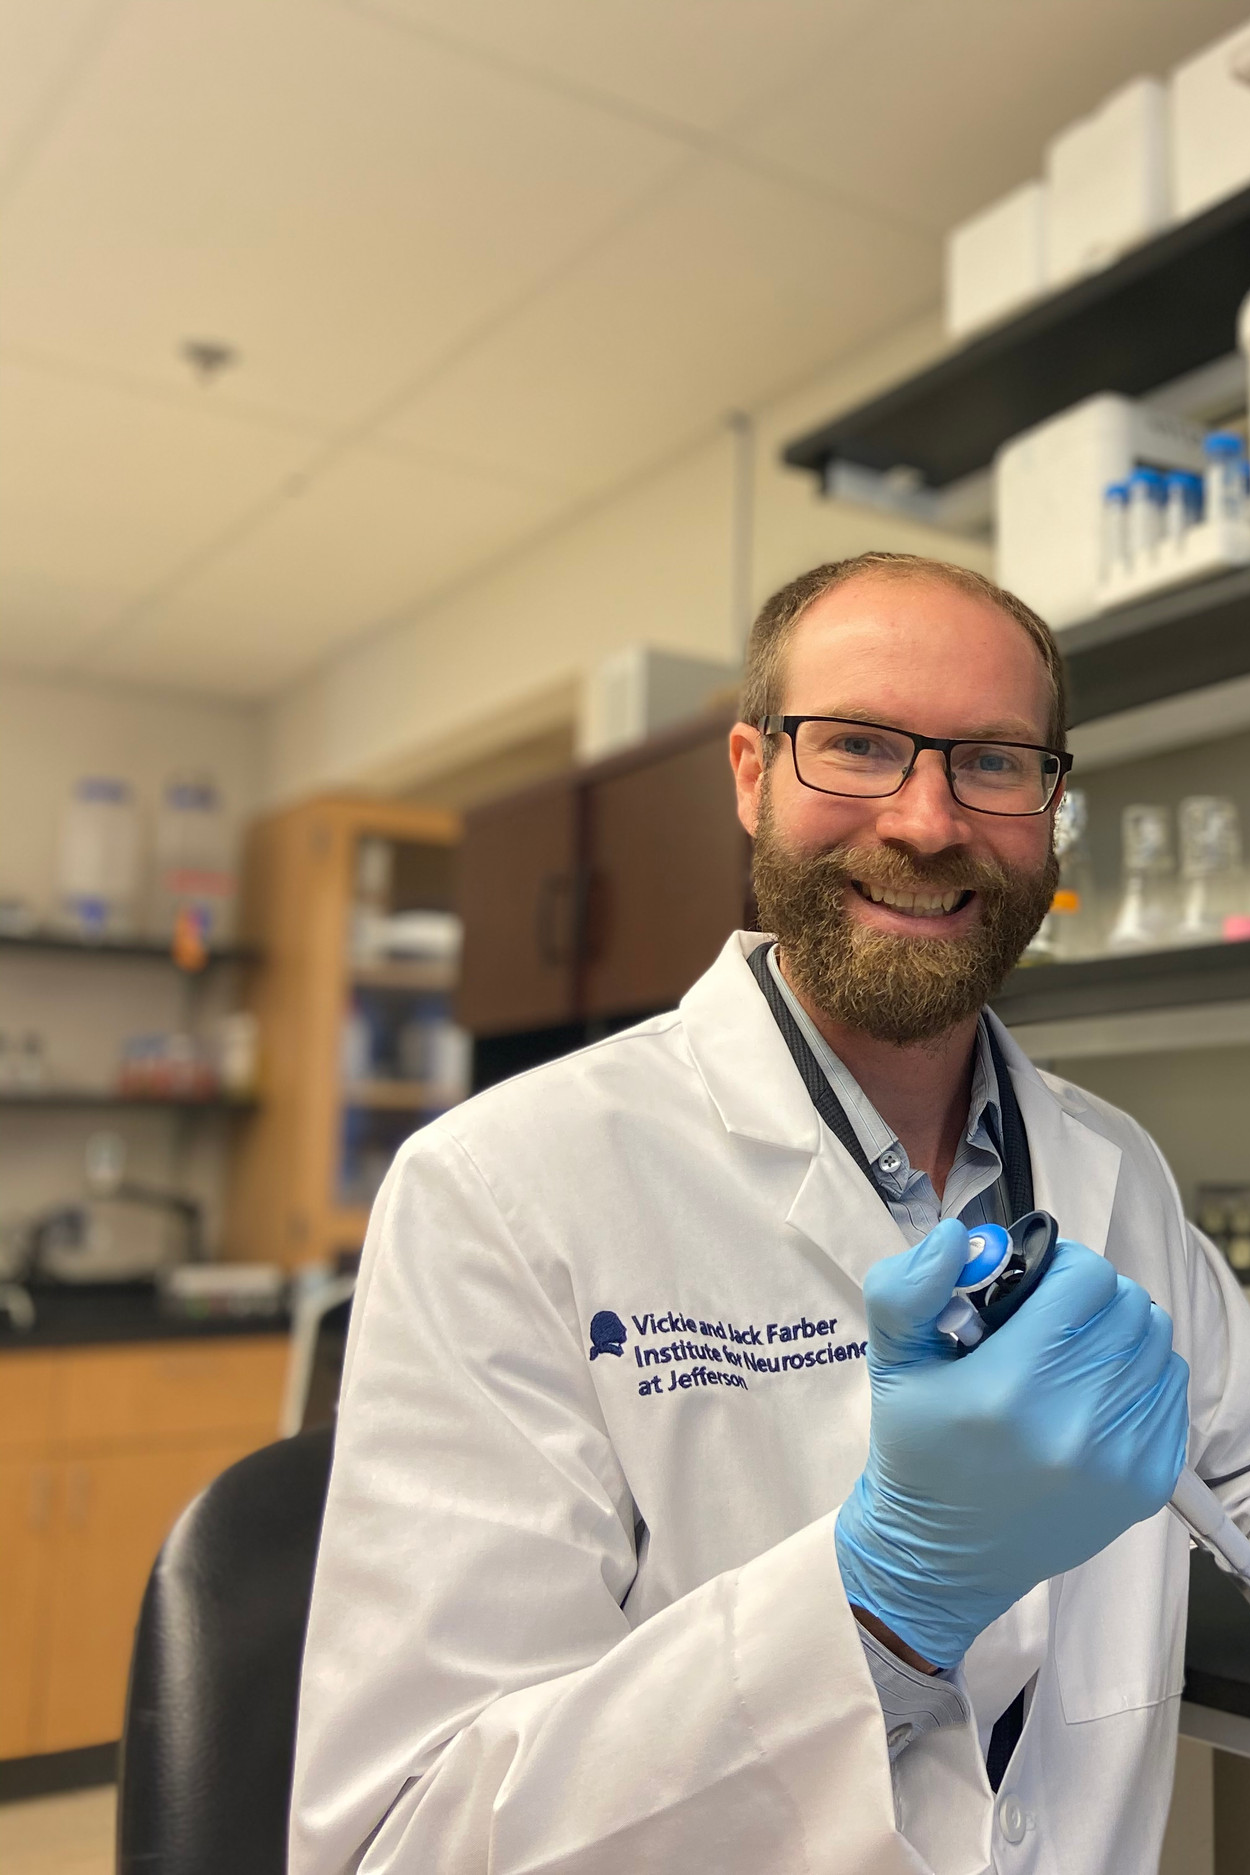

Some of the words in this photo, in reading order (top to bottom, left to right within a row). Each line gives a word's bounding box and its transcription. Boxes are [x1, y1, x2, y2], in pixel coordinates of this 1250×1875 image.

[631, 1311, 697, 1336] Vickie
[699, 1320, 727, 1340] and
[728, 1322, 765, 1346] Jack
[766, 1316, 838, 1345] Farber
[634, 1339, 722, 1368] Institute
[722, 1345, 744, 1368] for
[743, 1339, 869, 1373] Neuroscienc
[638, 1376, 664, 1396] at
[667, 1366, 749, 1391] Jefferson
